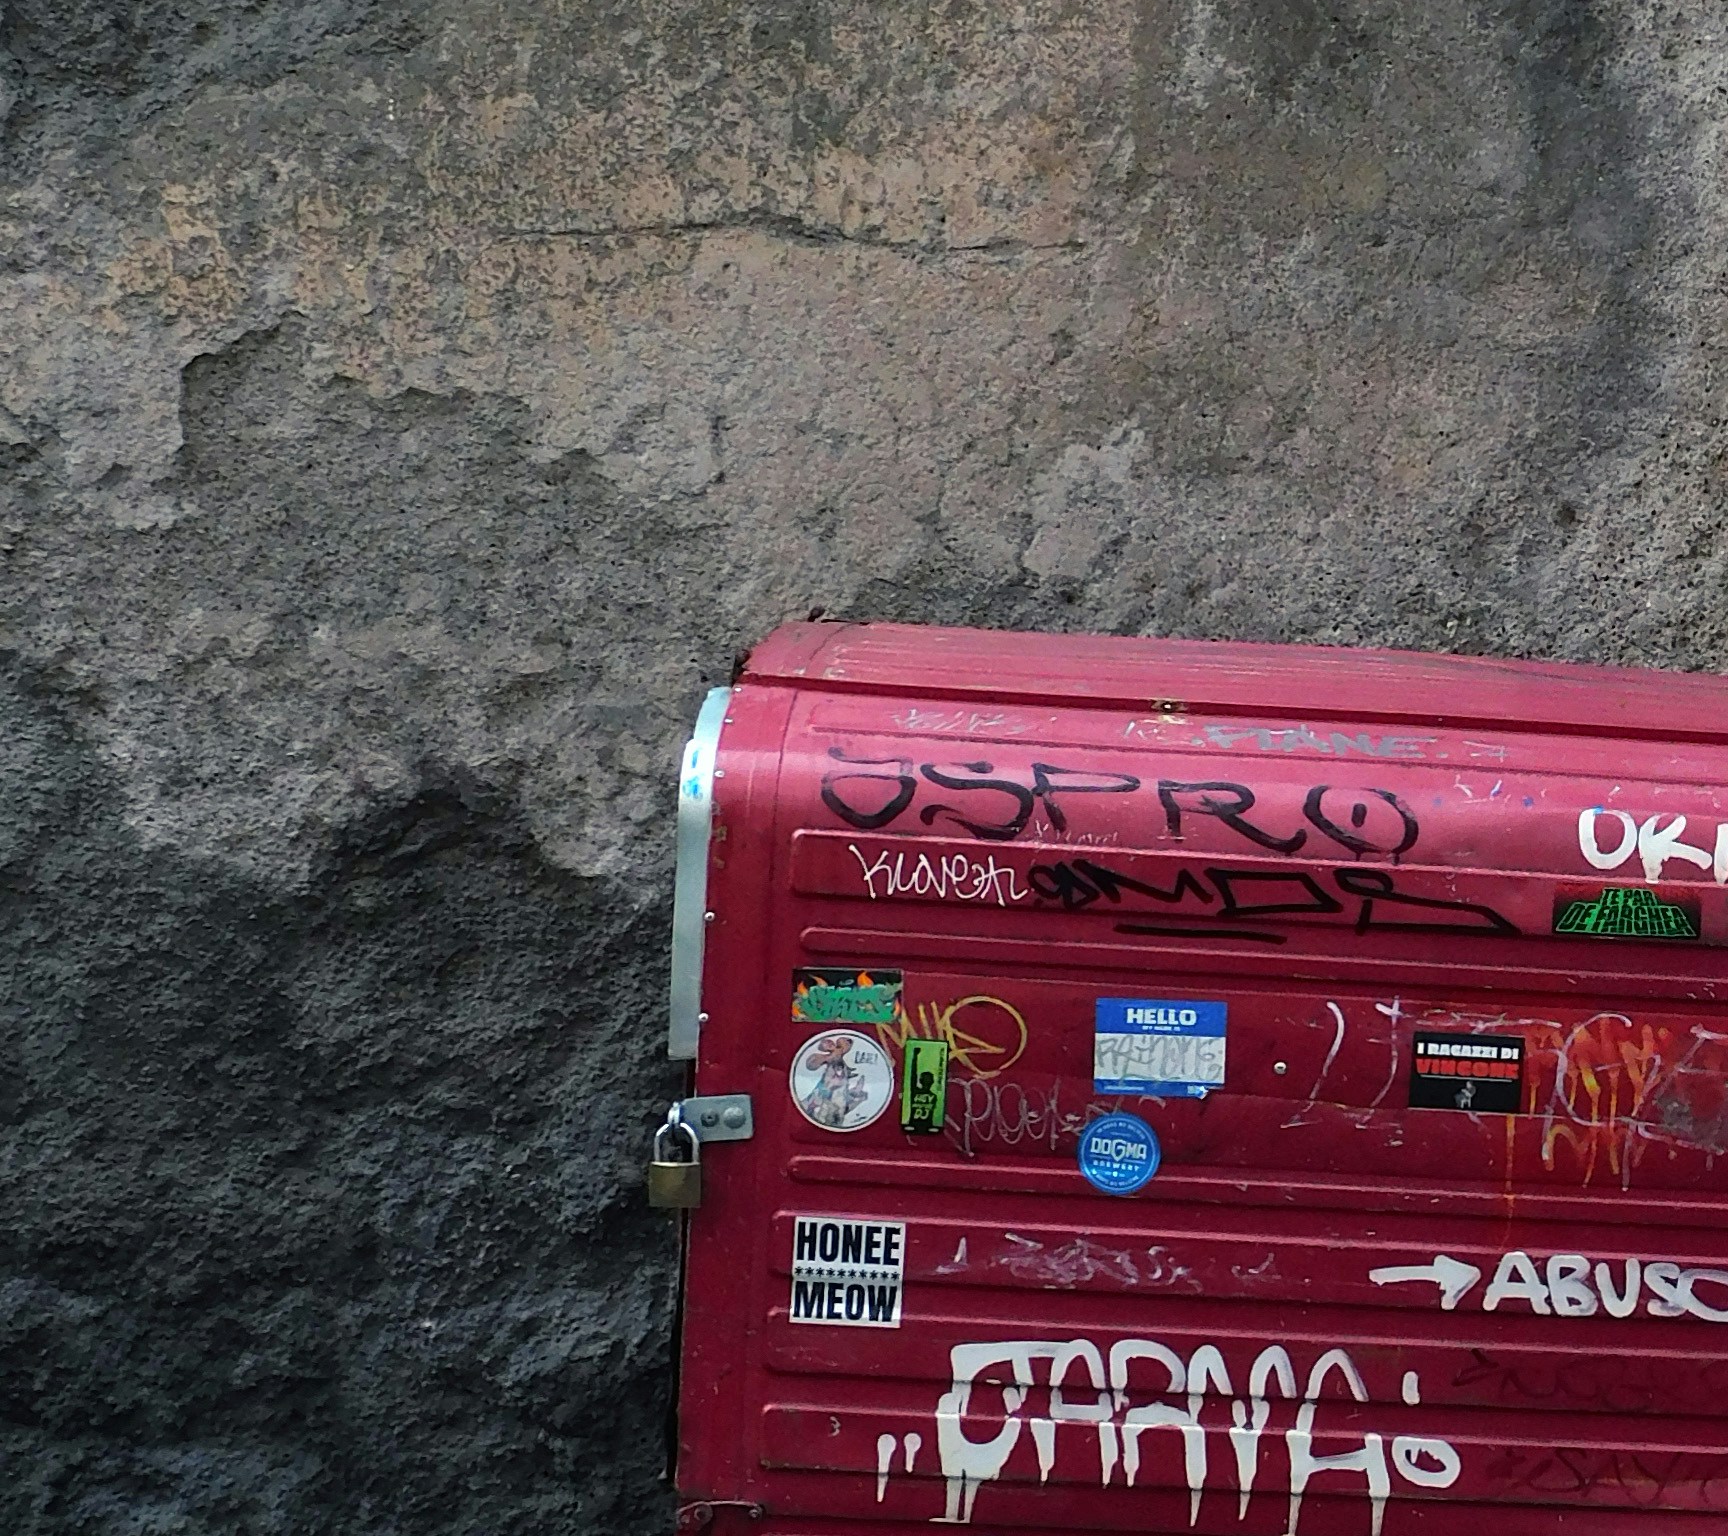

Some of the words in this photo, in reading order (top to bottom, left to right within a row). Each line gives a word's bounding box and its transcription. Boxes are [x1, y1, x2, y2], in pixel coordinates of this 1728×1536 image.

[1126, 1008, 1197, 1026] HELLO
[1416, 1042, 1425, 1055] I
[1427, 1043, 1498, 1059] RAGAZZI
[1500, 1047, 1520, 1060] DI
[1090, 1137, 1148, 1162] DOGMA
[796, 1221, 901, 1266] HONEE
[792, 1280, 898, 1322] MEOW
